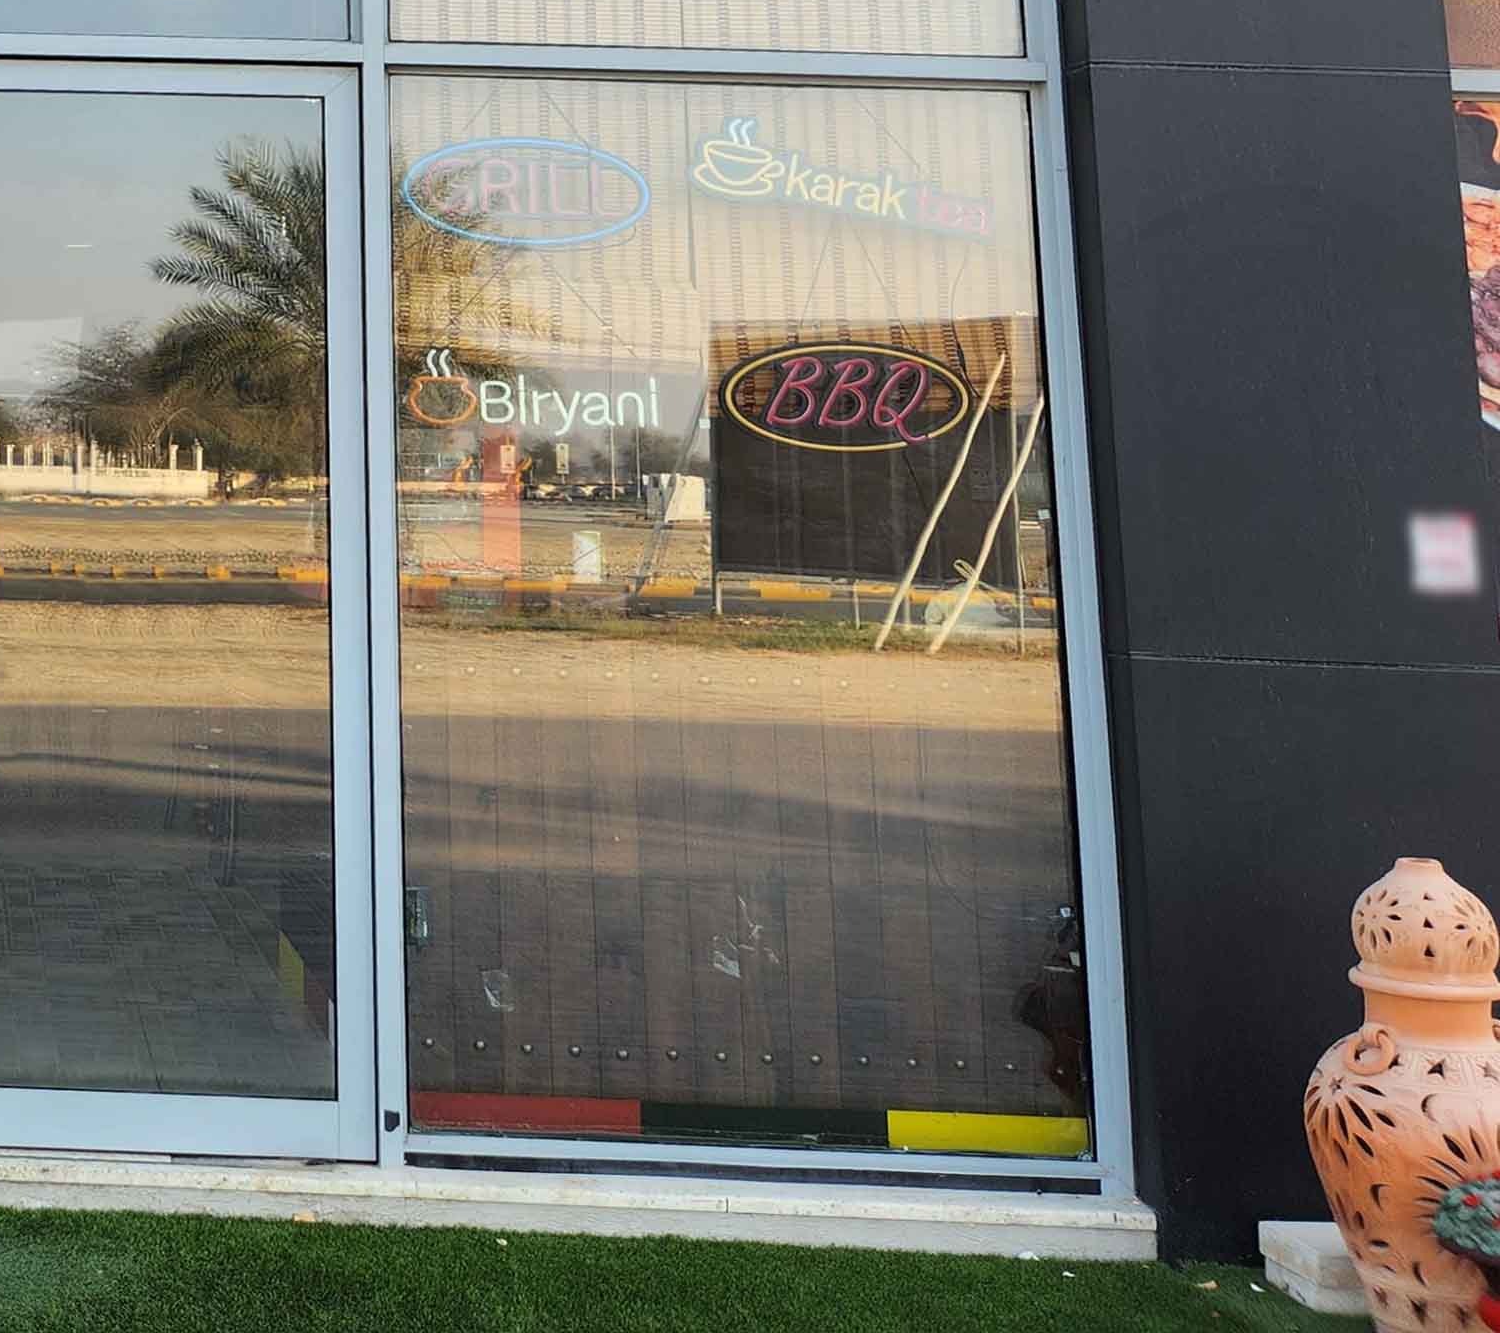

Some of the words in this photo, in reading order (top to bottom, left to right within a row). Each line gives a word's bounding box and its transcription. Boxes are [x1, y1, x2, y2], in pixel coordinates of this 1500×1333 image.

[421, 158, 635, 219] GRILL
[784, 153, 907, 221] karak
[765, 355, 932, 442] BBQ
